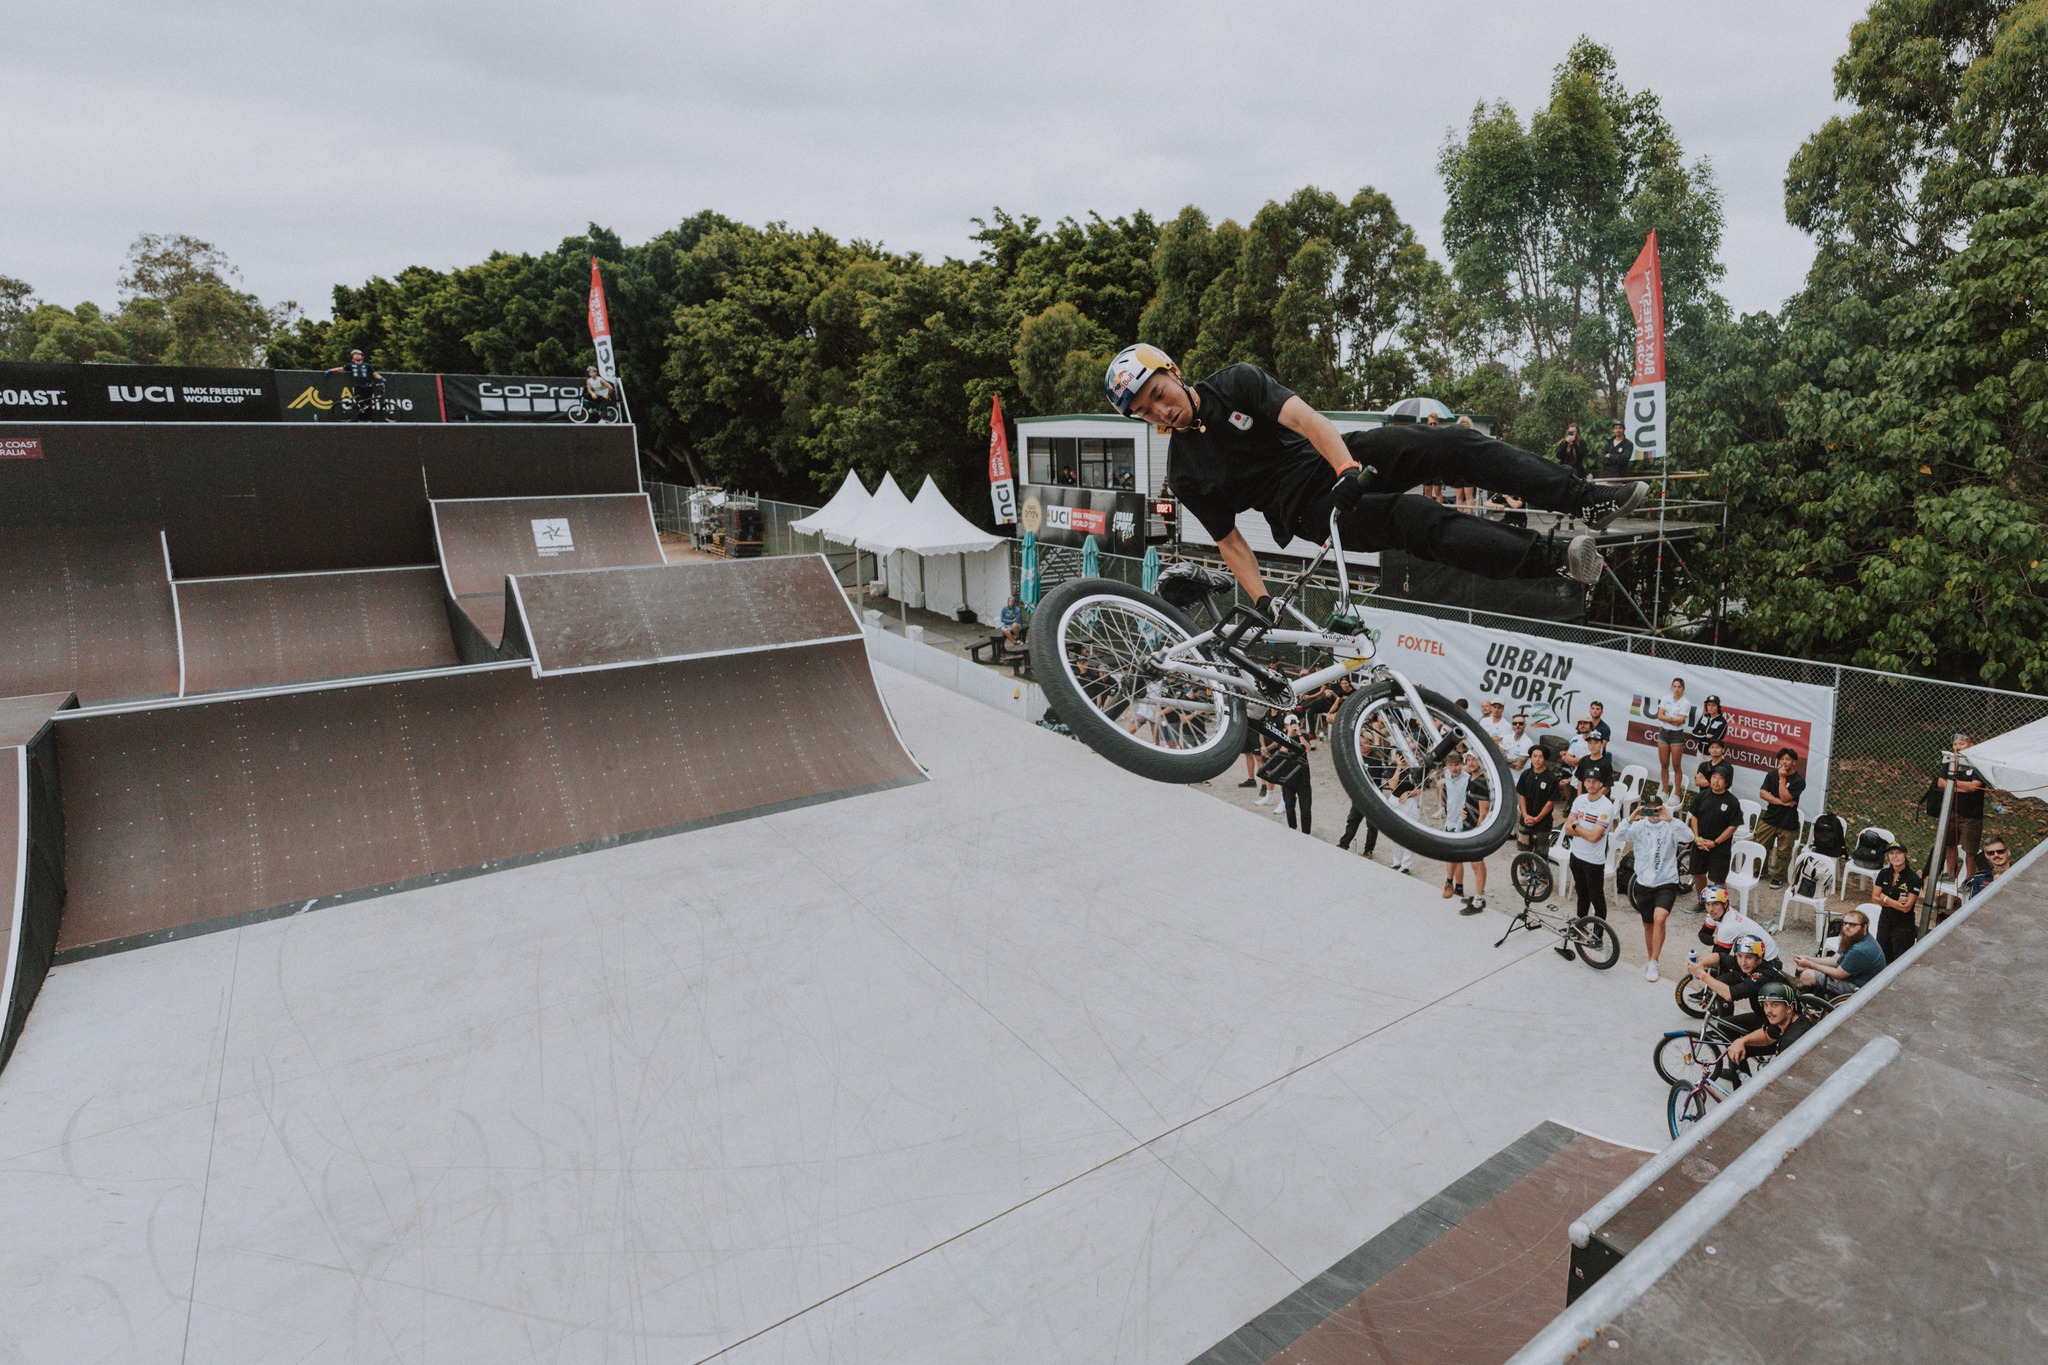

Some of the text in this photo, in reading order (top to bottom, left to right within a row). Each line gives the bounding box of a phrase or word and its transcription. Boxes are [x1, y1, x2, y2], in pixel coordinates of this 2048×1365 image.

[1123, 372, 1135, 387] Bull
[0, 389, 68, 406] OAST.
[120, 385, 176, 403] UCI
[182, 386, 262, 396] BMX FREESTYLE
[478, 382, 580, 398] GoPro
[183, 395, 245, 404] WORLD CUP
[5, 441, 38, 449] COAST
[1051, 509, 1070, 525] UCI
[1072, 511, 1104, 523] BMX FREESTYLE
[1072, 519, 1097, 530] WORLD CUP
[1113, 511, 1134, 523] URBAN
[1397, 634, 1446, 657] FOXTEL
[1485, 642, 1574, 682] URBAN
[1479, 668, 1563, 705] SPORT
[1642, 696, 1698, 728] UI
[1738, 715, 1802, 738] FREESTYLE
[1727, 725, 1779, 745] RLD CUP
